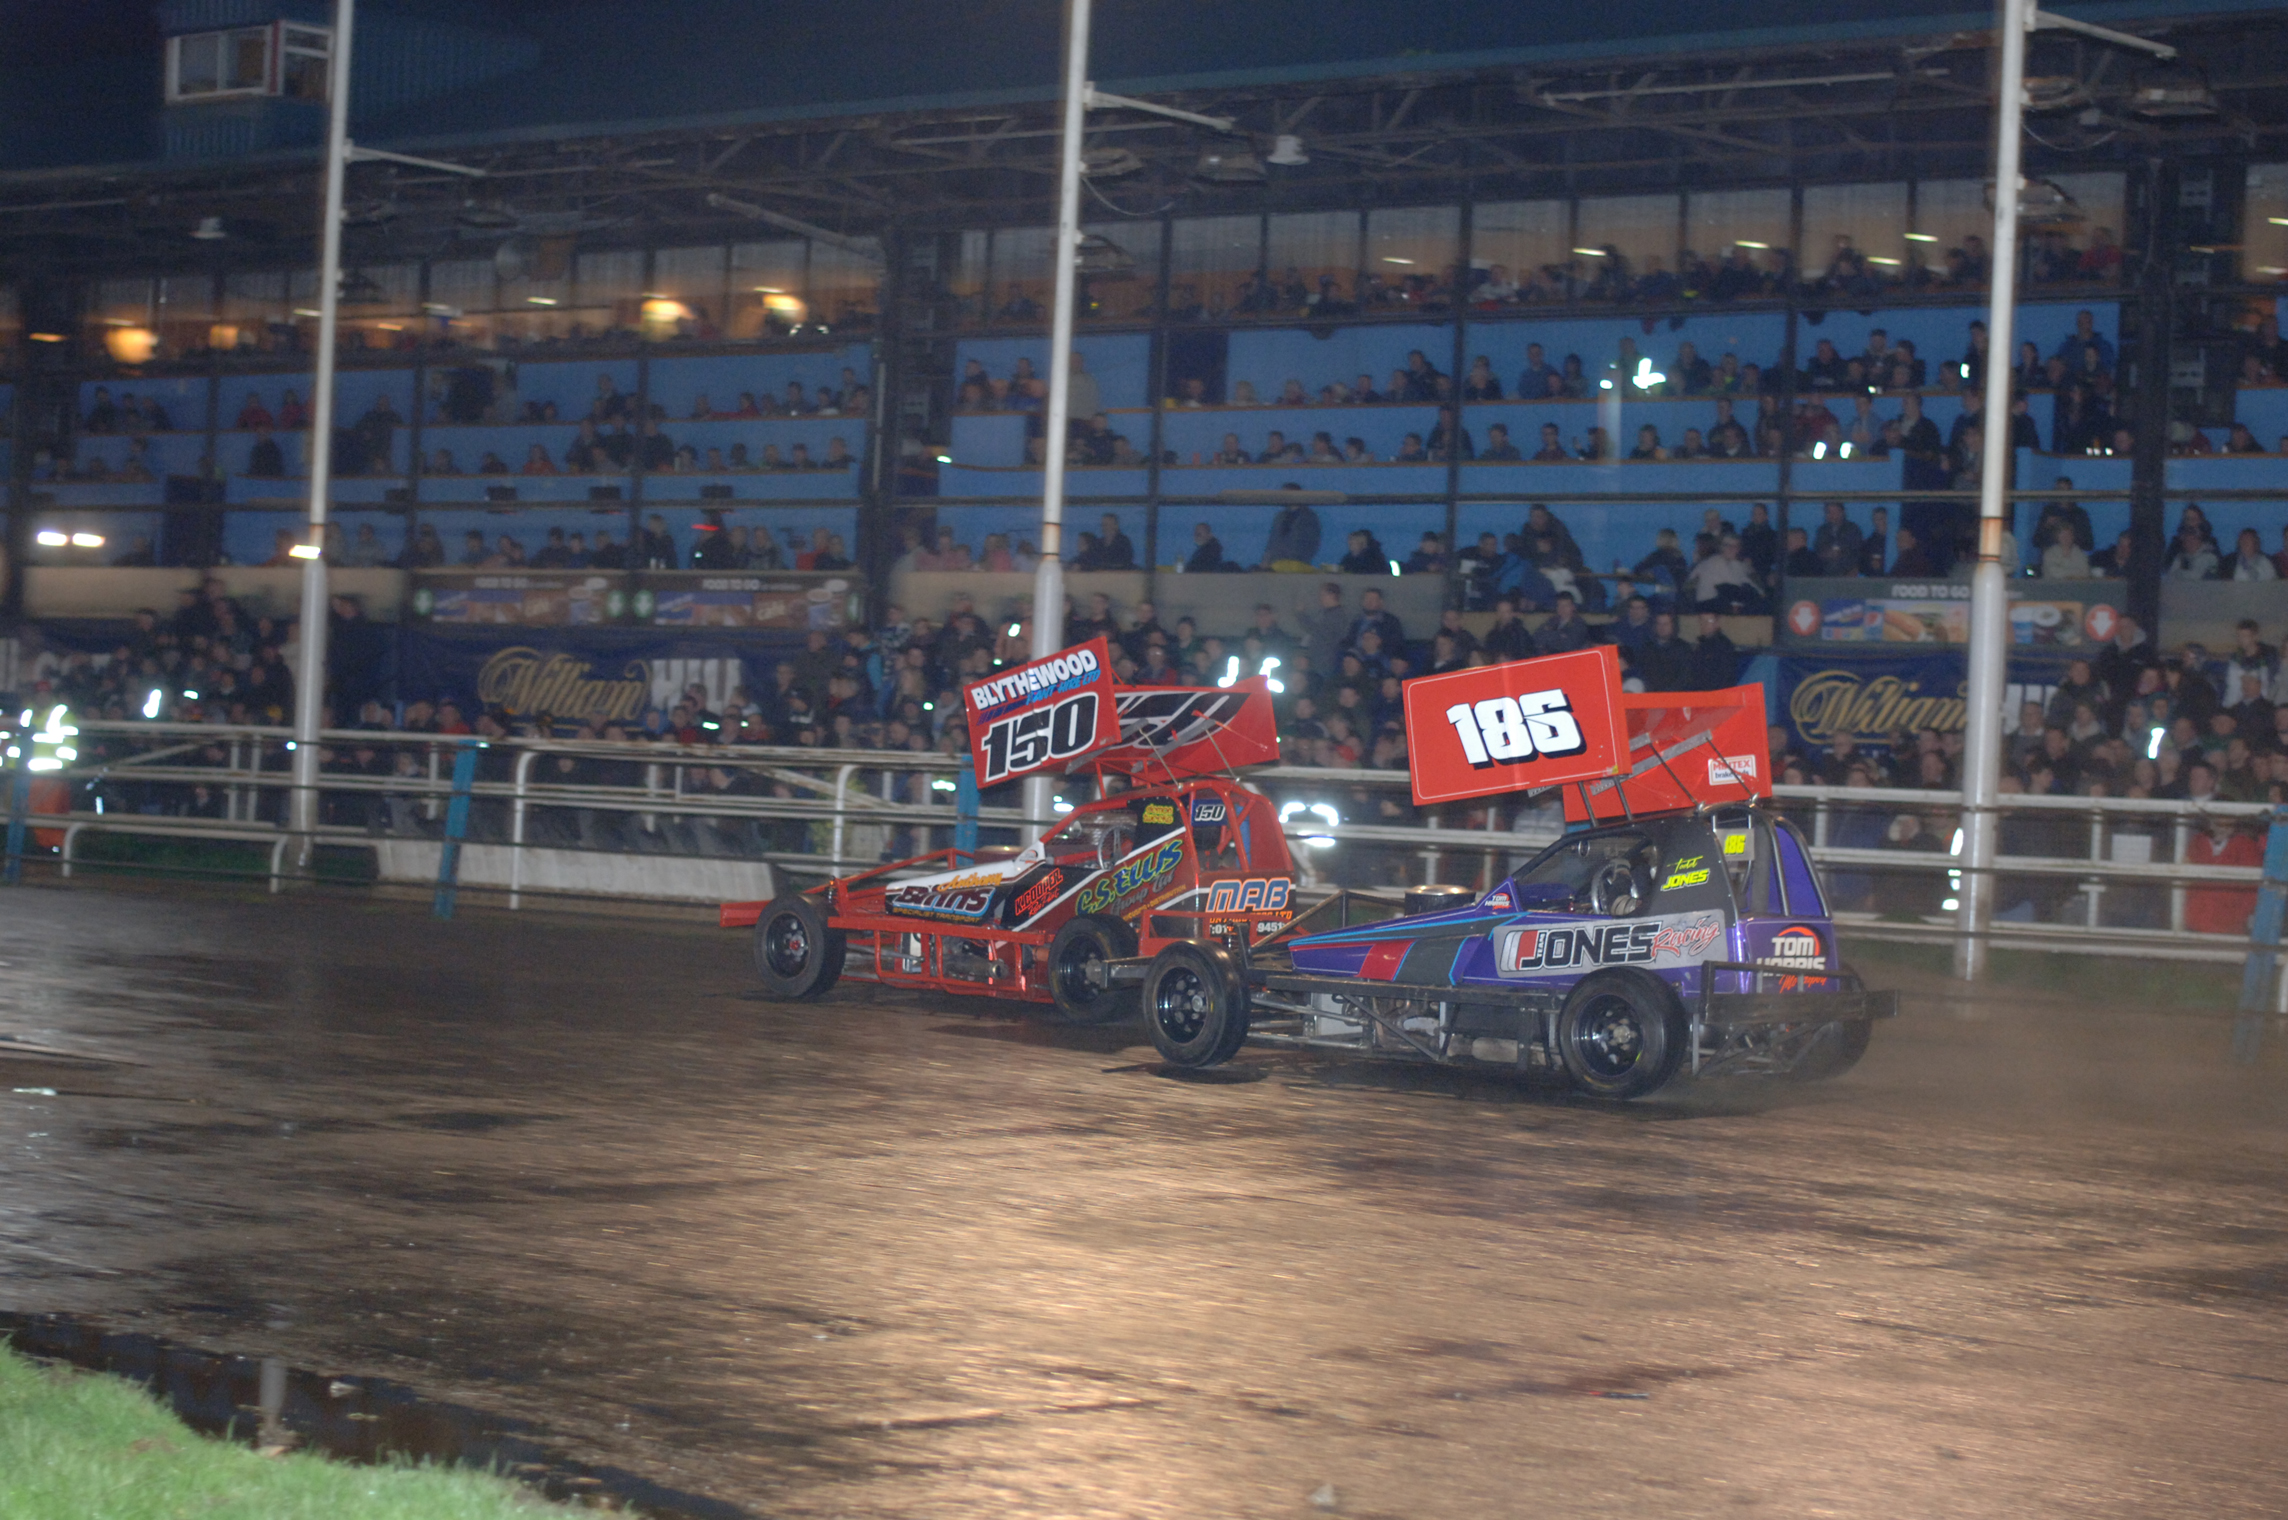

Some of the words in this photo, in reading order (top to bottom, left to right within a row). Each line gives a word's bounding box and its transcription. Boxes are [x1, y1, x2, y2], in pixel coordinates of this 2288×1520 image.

[1892, 585, 1928, 598] FOOD
[1931, 585, 1948, 598] TO
[1950, 585, 1970, 598] GO
[478, 646, 652, 721] William
[971, 649, 1099, 710] BLYTHEWOOD
[1083, 669, 1101, 686] LTD
[981, 692, 1099, 782] 150
[1446, 688, 1585, 768] 186
[1194, 804, 1226, 821] 150
[1724, 834, 1747, 854] 186
[937, 872, 1003, 892] Anthony
[1661, 868, 1710, 891] JONES
[1205, 877, 1291, 912] MAB
[893, 906, 934, 918] SPECIALIST
[936, 911, 981, 924] TRANSPORT
[1519, 921, 1662, 970] JONES
[1651, 914, 1721, 957] Racing
[1771, 937, 1815, 956] TOM
